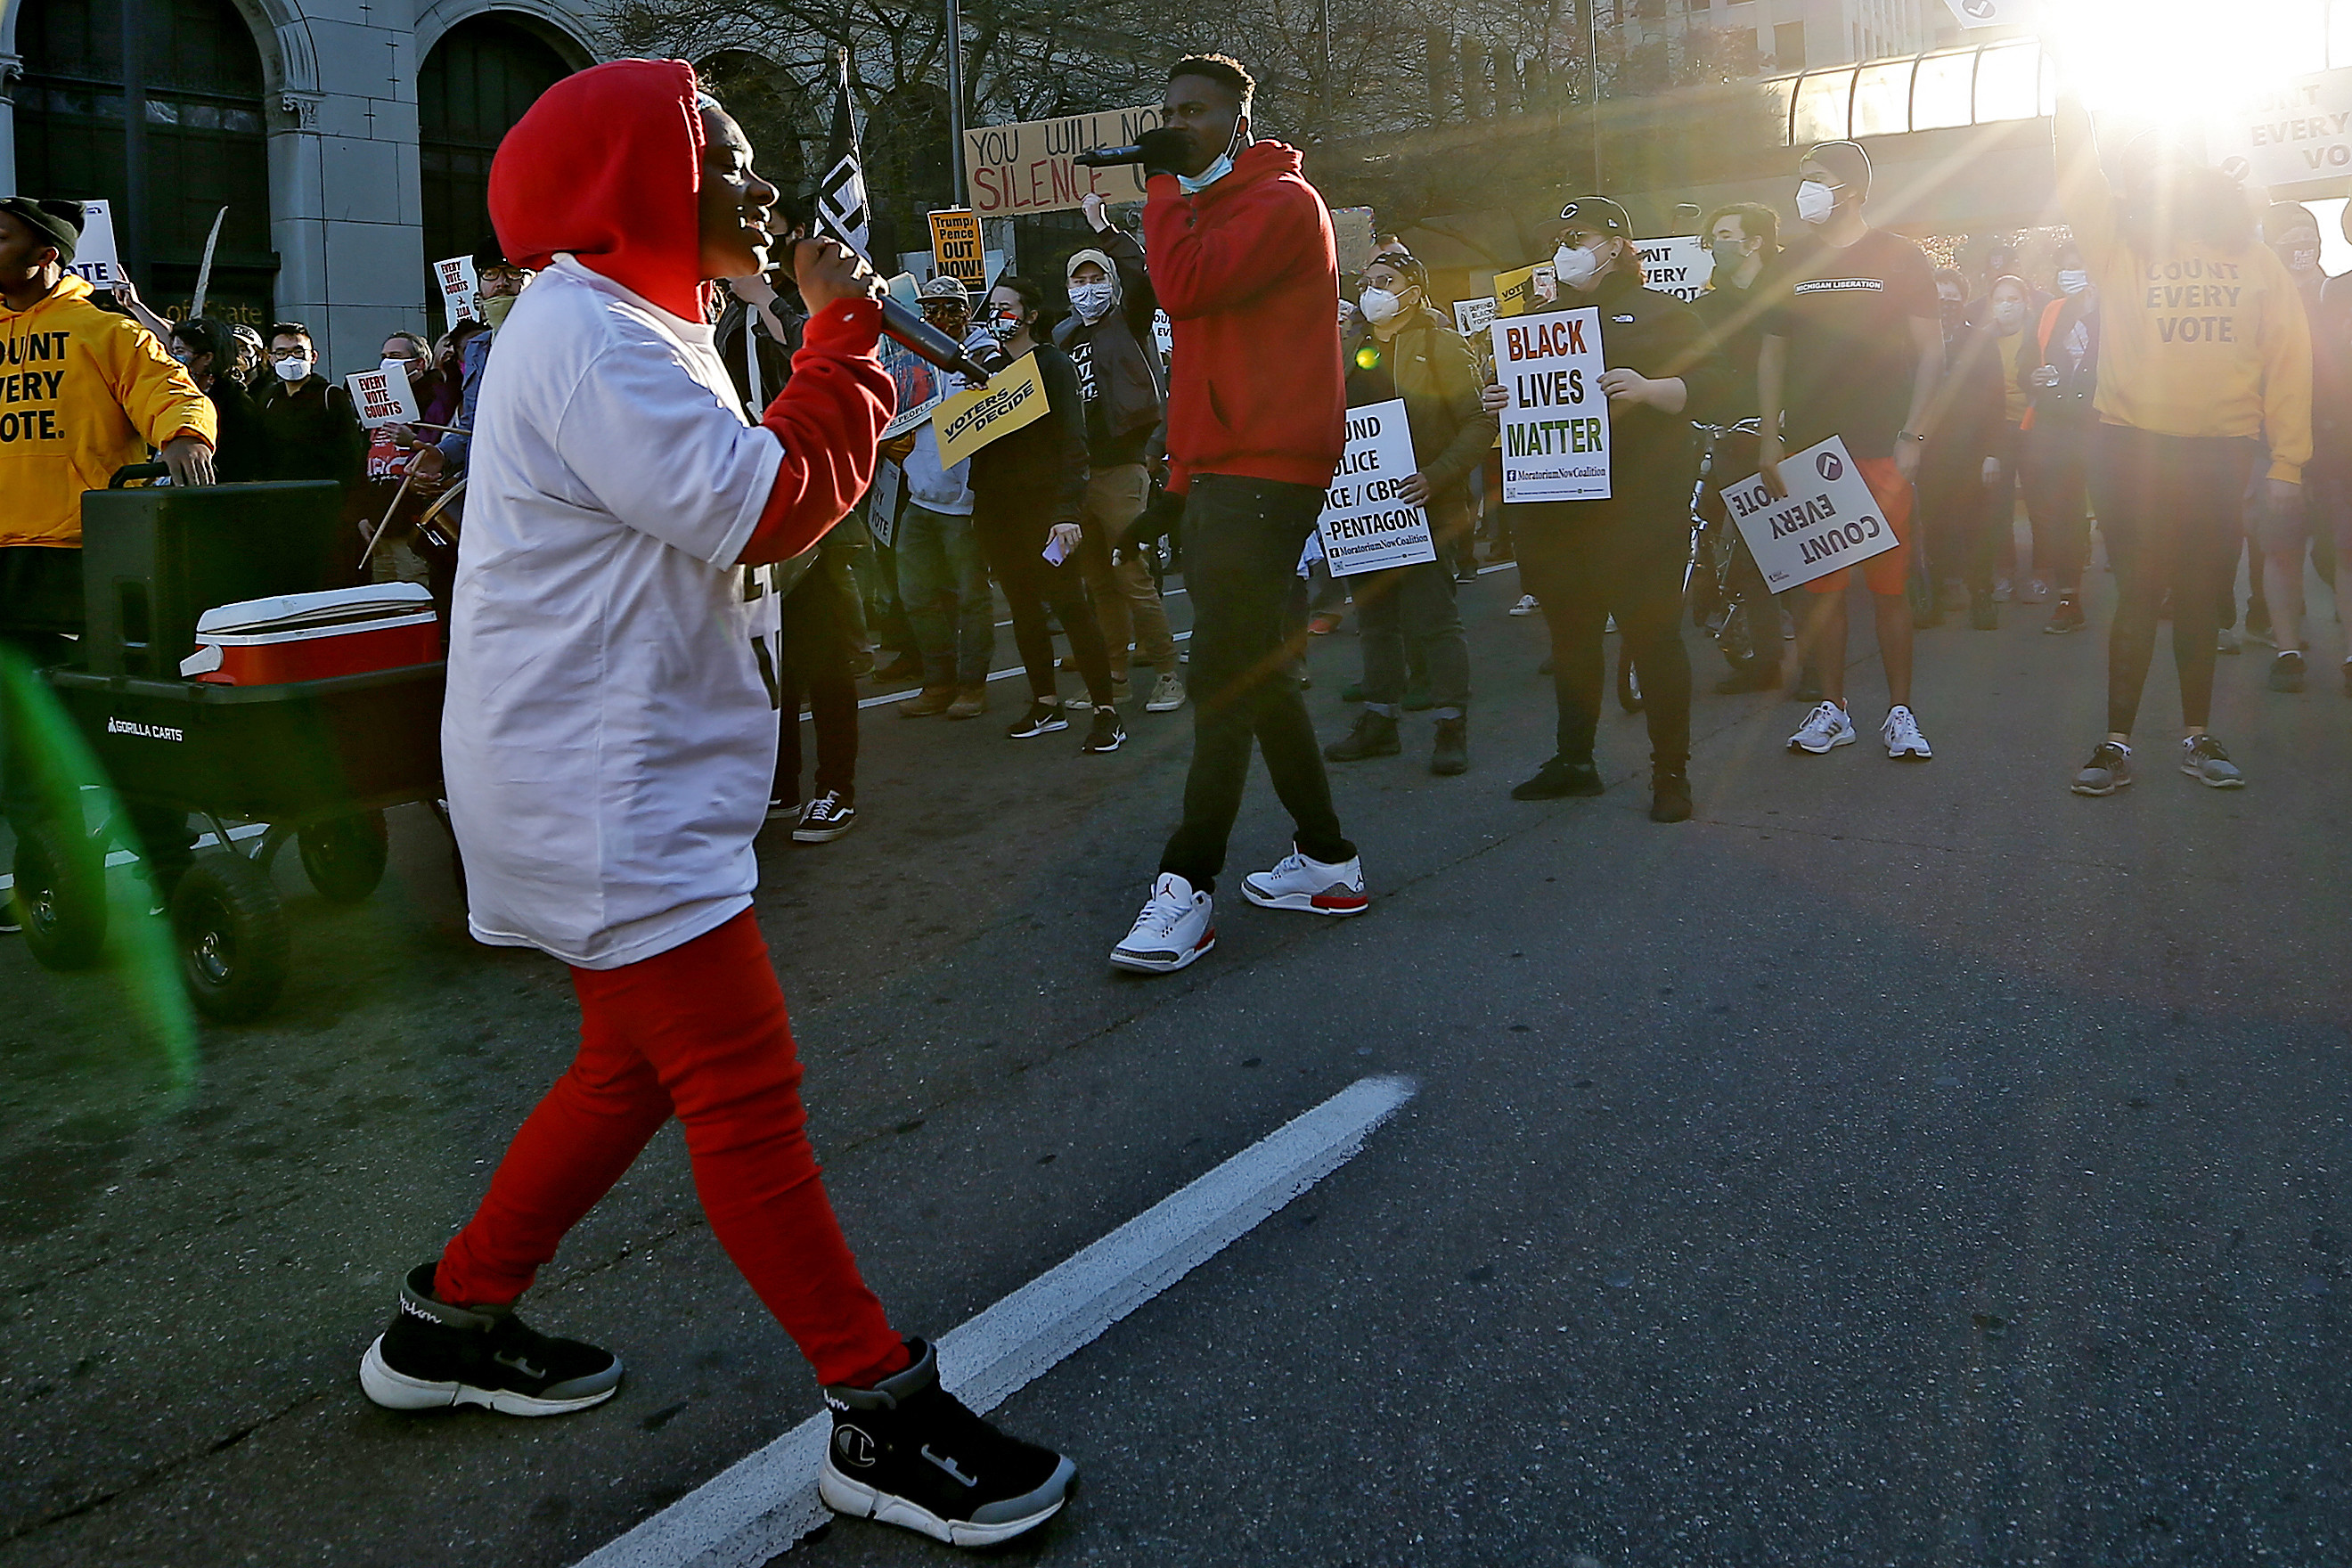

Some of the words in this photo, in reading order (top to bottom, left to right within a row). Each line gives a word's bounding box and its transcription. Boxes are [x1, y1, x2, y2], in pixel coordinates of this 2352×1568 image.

[970, 129, 1018, 167] YOU
[1044, 117, 1107, 155] WILL
[2251, 111, 2350, 147] EVERY
[2302, 144, 2352, 170] VO
[974, 157, 1112, 212] SILENCE
[939, 229, 974, 240] Pence
[943, 241, 974, 258] OUT
[937, 259, 983, 279] NOW!
[2145, 257, 2241, 282] COUNT
[1796, 282, 1832, 292] MICHIGAN
[1833, 280, 1881, 289] LIBERATION
[2146, 284, 2242, 309] EVERY
[1506, 320, 1588, 362] BLACK
[358, 374, 387, 392] EVERY
[364, 388, 390, 404] VOTE
[1517, 369, 1585, 409] LIVES
[363, 401, 403, 419] COUNTS
[944, 387, 1009, 437] VOTERS
[974, 383, 1035, 432] DECIDE
[1507, 417, 1603, 458] MATTER
[1517, 466, 1606, 481] MoratoriumNowCoalition
[1325, 486, 1352, 510] ICE
[1366, 478, 1400, 502] CBP
[1731, 485, 1789, 519] OTE
[1768, 493, 1837, 541] EVERY
[1340, 535, 1428, 557] MoratoriumNowCoalition
[1800, 515, 1881, 566] COUNT
[116, 720, 152, 738] GORILLA
[152, 725, 184, 742] CARTS
